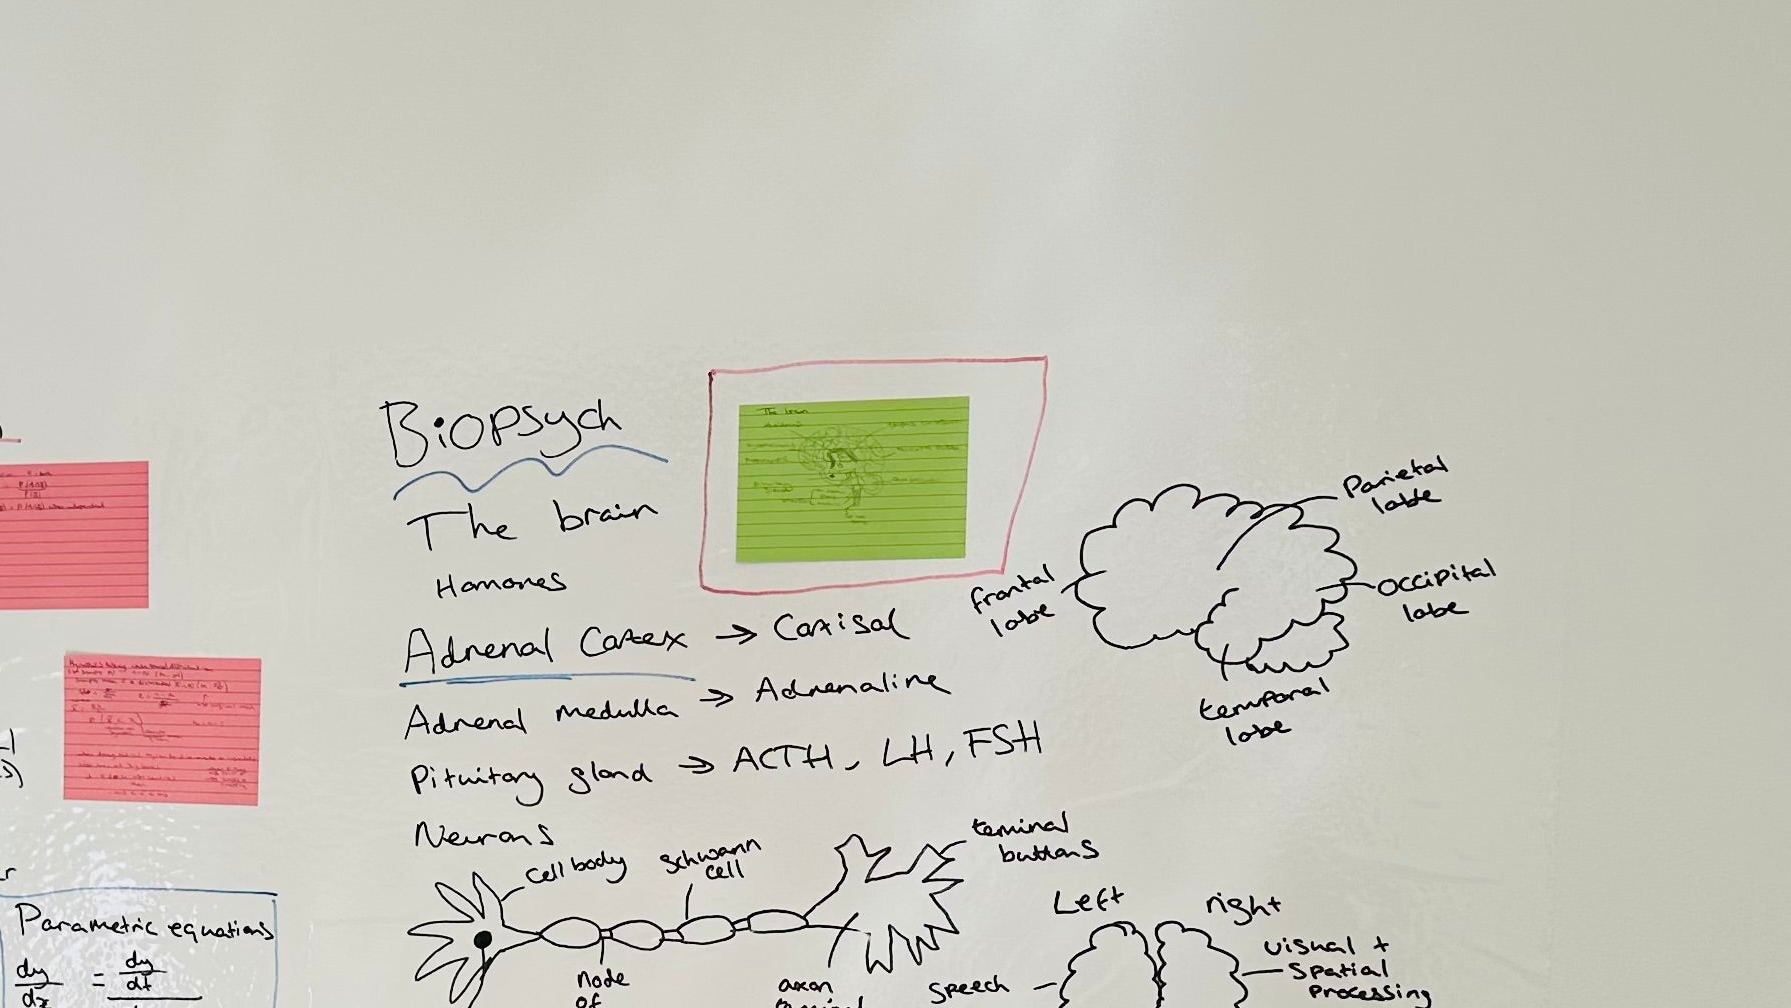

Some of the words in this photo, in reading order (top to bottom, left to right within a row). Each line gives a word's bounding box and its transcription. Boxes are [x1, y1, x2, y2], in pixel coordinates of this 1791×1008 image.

[378, 398, 623, 473] Biopsych
[406, 502, 518, 552] The
[552, 499, 659, 533] brain
[404, 626, 554, 675] Adrenal
[404, 703, 528, 740] Adrenal
[962, 719, 1042, 759] FSH
[705, 858, 745, 881] cell
[14, 902, 158, 937] Parametric
[167, 920, 275, 944] equations
